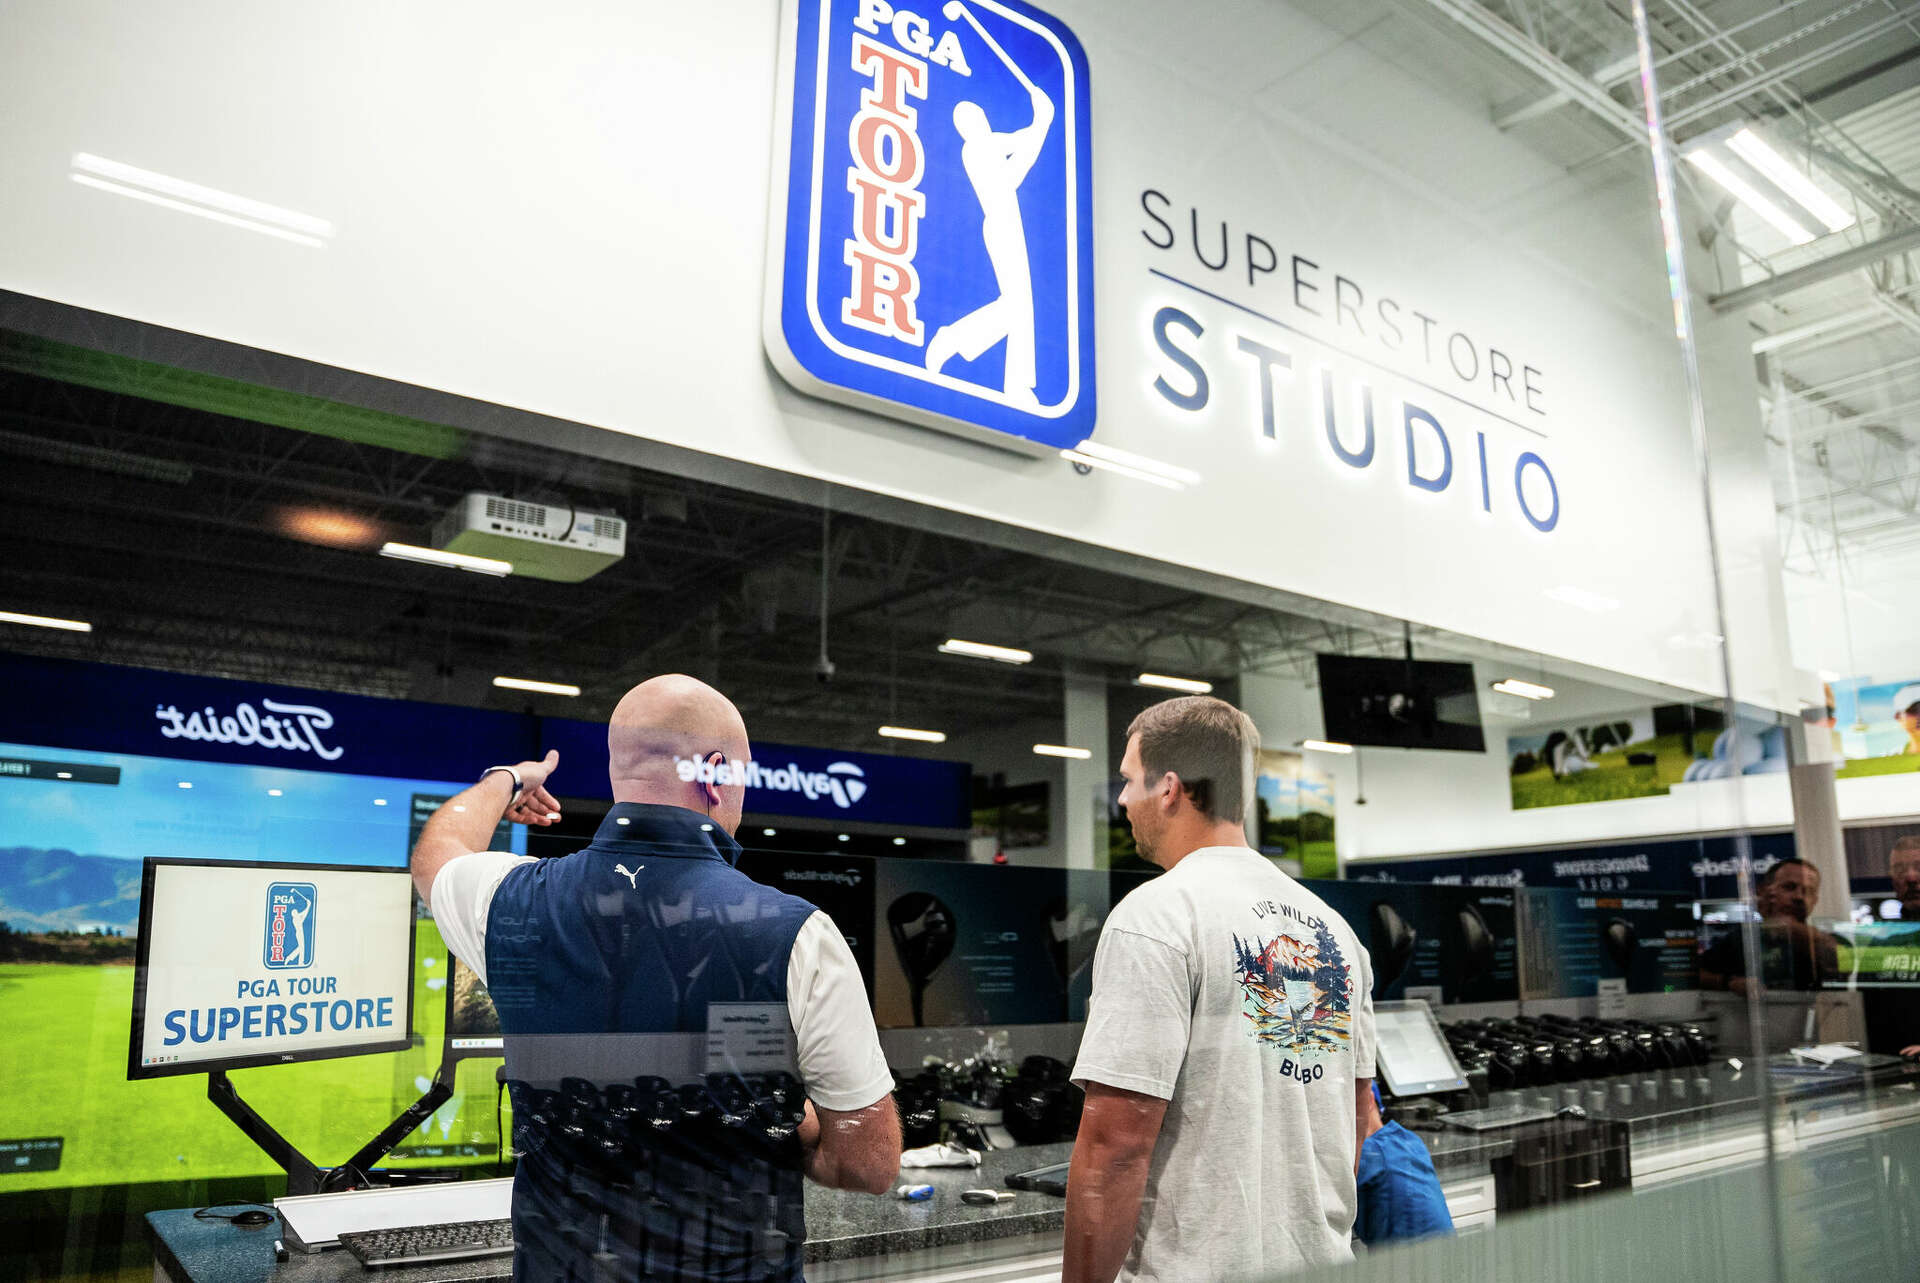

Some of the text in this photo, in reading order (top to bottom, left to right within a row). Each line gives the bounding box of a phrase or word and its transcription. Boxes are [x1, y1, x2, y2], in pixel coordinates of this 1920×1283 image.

[853, 0, 972, 76] PGA
[842, 32, 929, 347] TOUR
[1141, 189, 1547, 416] SUPERSTORE
[1152, 306, 1560, 532] STUDIO
[274, 895, 295, 905] PGA
[1251, 900, 1317, 929] LIVE WILD
[271, 905, 287, 962] TOUR
[237, 976, 337, 999] PGA TOUR
[163, 997, 394, 1046] SUPERSTORE
